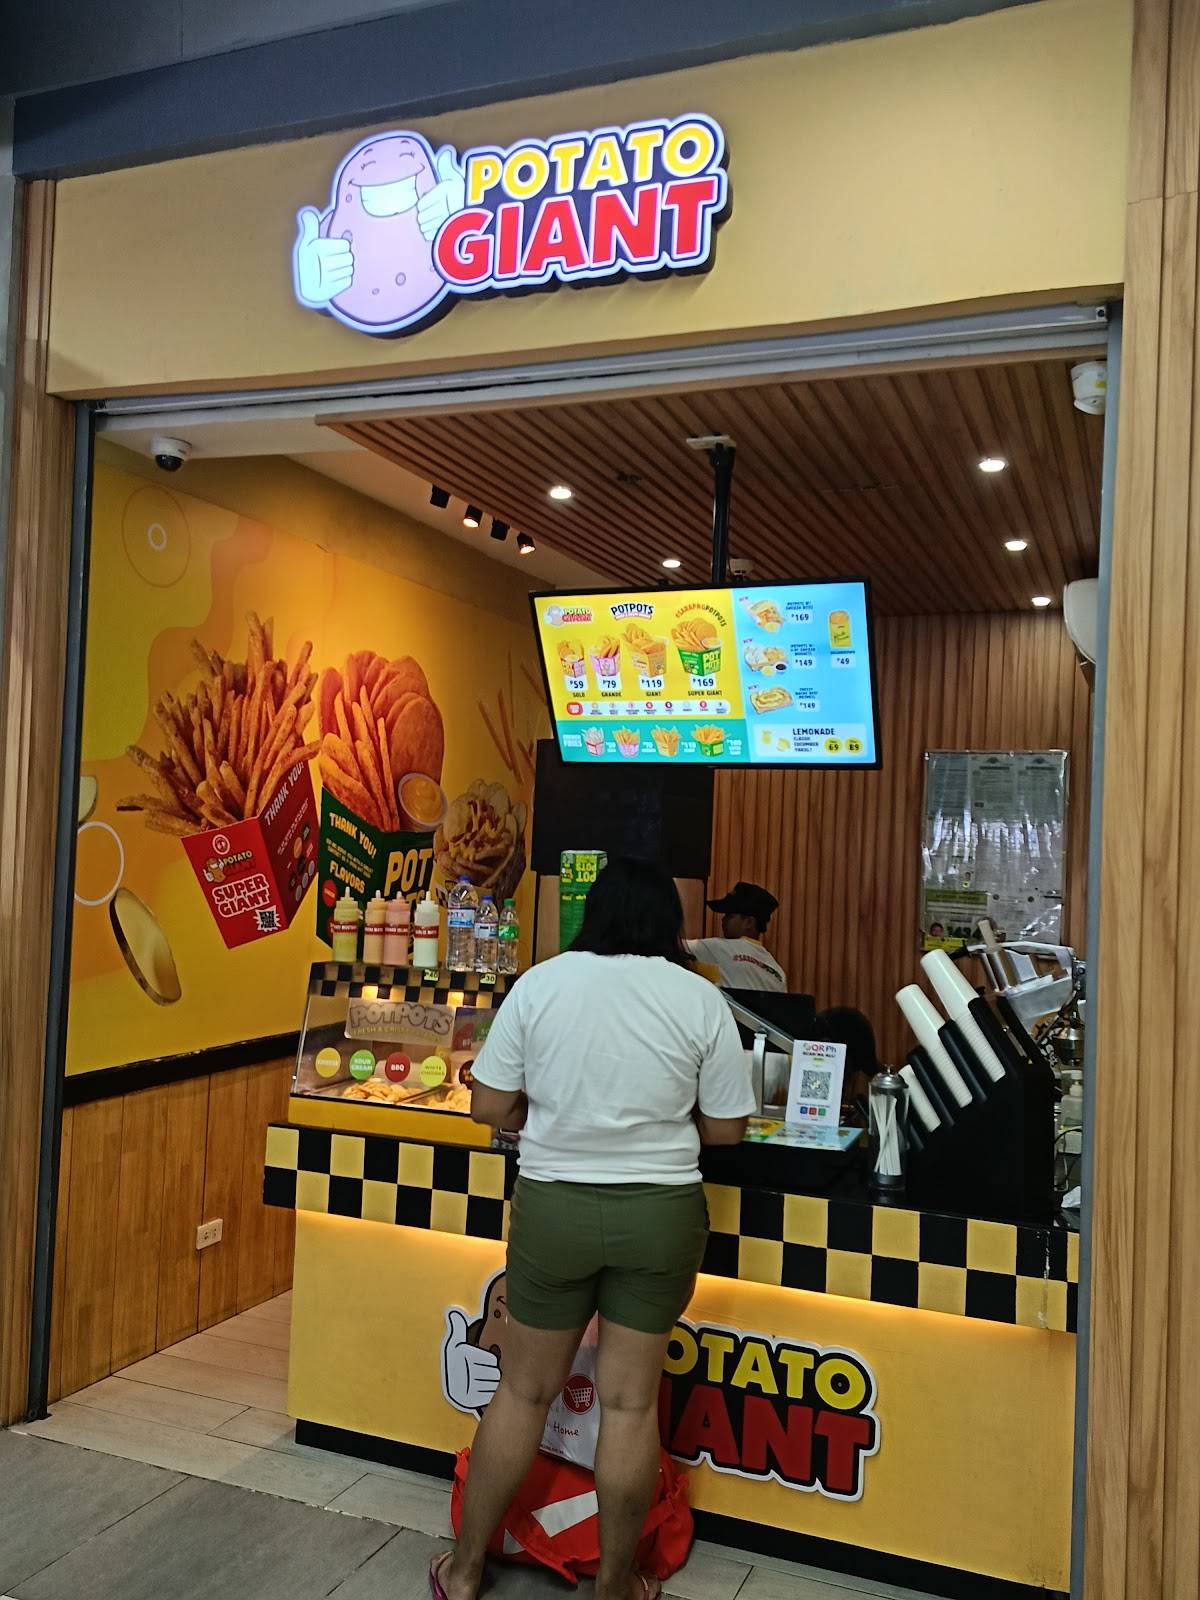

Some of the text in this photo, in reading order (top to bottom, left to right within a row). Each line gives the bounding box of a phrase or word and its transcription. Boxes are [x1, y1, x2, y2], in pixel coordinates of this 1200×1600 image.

[469, 123, 715, 203] POTATO
[437, 178, 718, 282] GIANT
[610, 603, 654, 615] POTPOTS
[569, 680, 584, 689] ₱59
[602, 680, 616, 689] ₱79
[641, 679, 662, 688] ₱119
[692, 678, 714, 687] ₱169
[792, 728, 835, 736] LEMONADE
[264, 782, 289, 826] THANK
[329, 812, 357, 840] THANK
[359, 830, 377, 859] YOU!
[223, 850, 253, 865] POTATO
[329, 860, 366, 894] FLAVORS
[384, 849, 433, 897] POT
[576, 871, 597, 882] POT
[213, 875, 268, 902] SUPER
[219, 889, 269, 916] GIANT
[350, 1003, 453, 1035] POTPOTS
[811, 1044, 825, 1052] QR
[390, 1063, 405, 1072] BBQ
[663, 1325, 866, 1410] OTATO
[553, 1421, 579, 1436] Home
